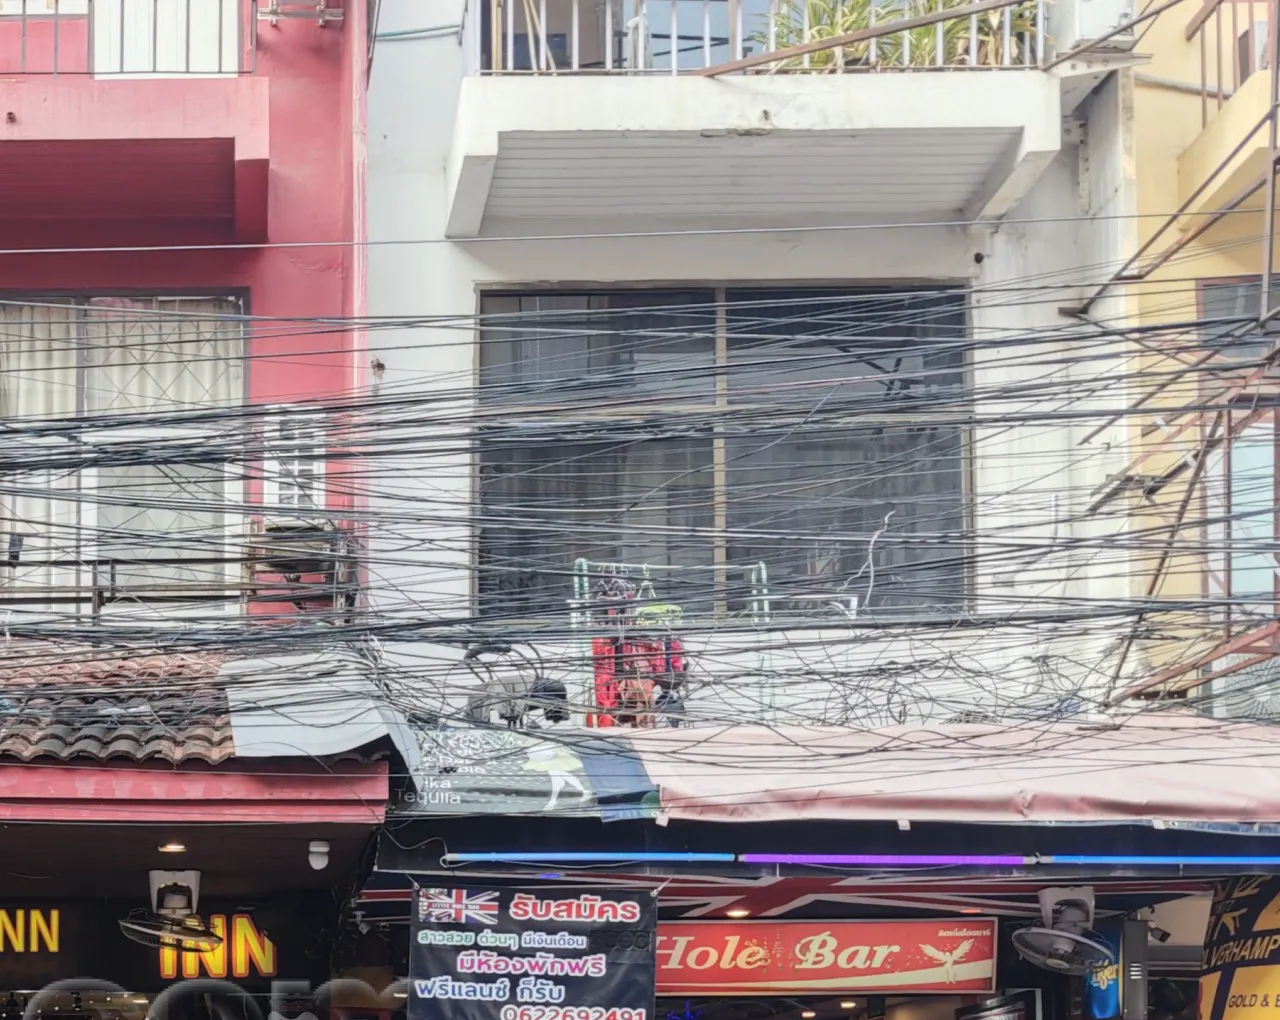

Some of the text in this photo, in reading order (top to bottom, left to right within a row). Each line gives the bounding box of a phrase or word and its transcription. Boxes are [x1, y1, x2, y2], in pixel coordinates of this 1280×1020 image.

[510, 893, 640, 922] รับสมัคร
[159, 912, 278, 979] INN
[418, 930, 475, 946] สาวสวย
[521, 931, 588, 949] มีเงินเดือน
[656, 934, 771, 970] Hole
[794, 931, 900, 970] Bar
[457, 951, 606, 976] มีห้องพักฟรี
[416, 976, 565, 1002] ฟรีแลนซ์ ก็รับ
[1228, 994, 1258, 1008] GOLD
